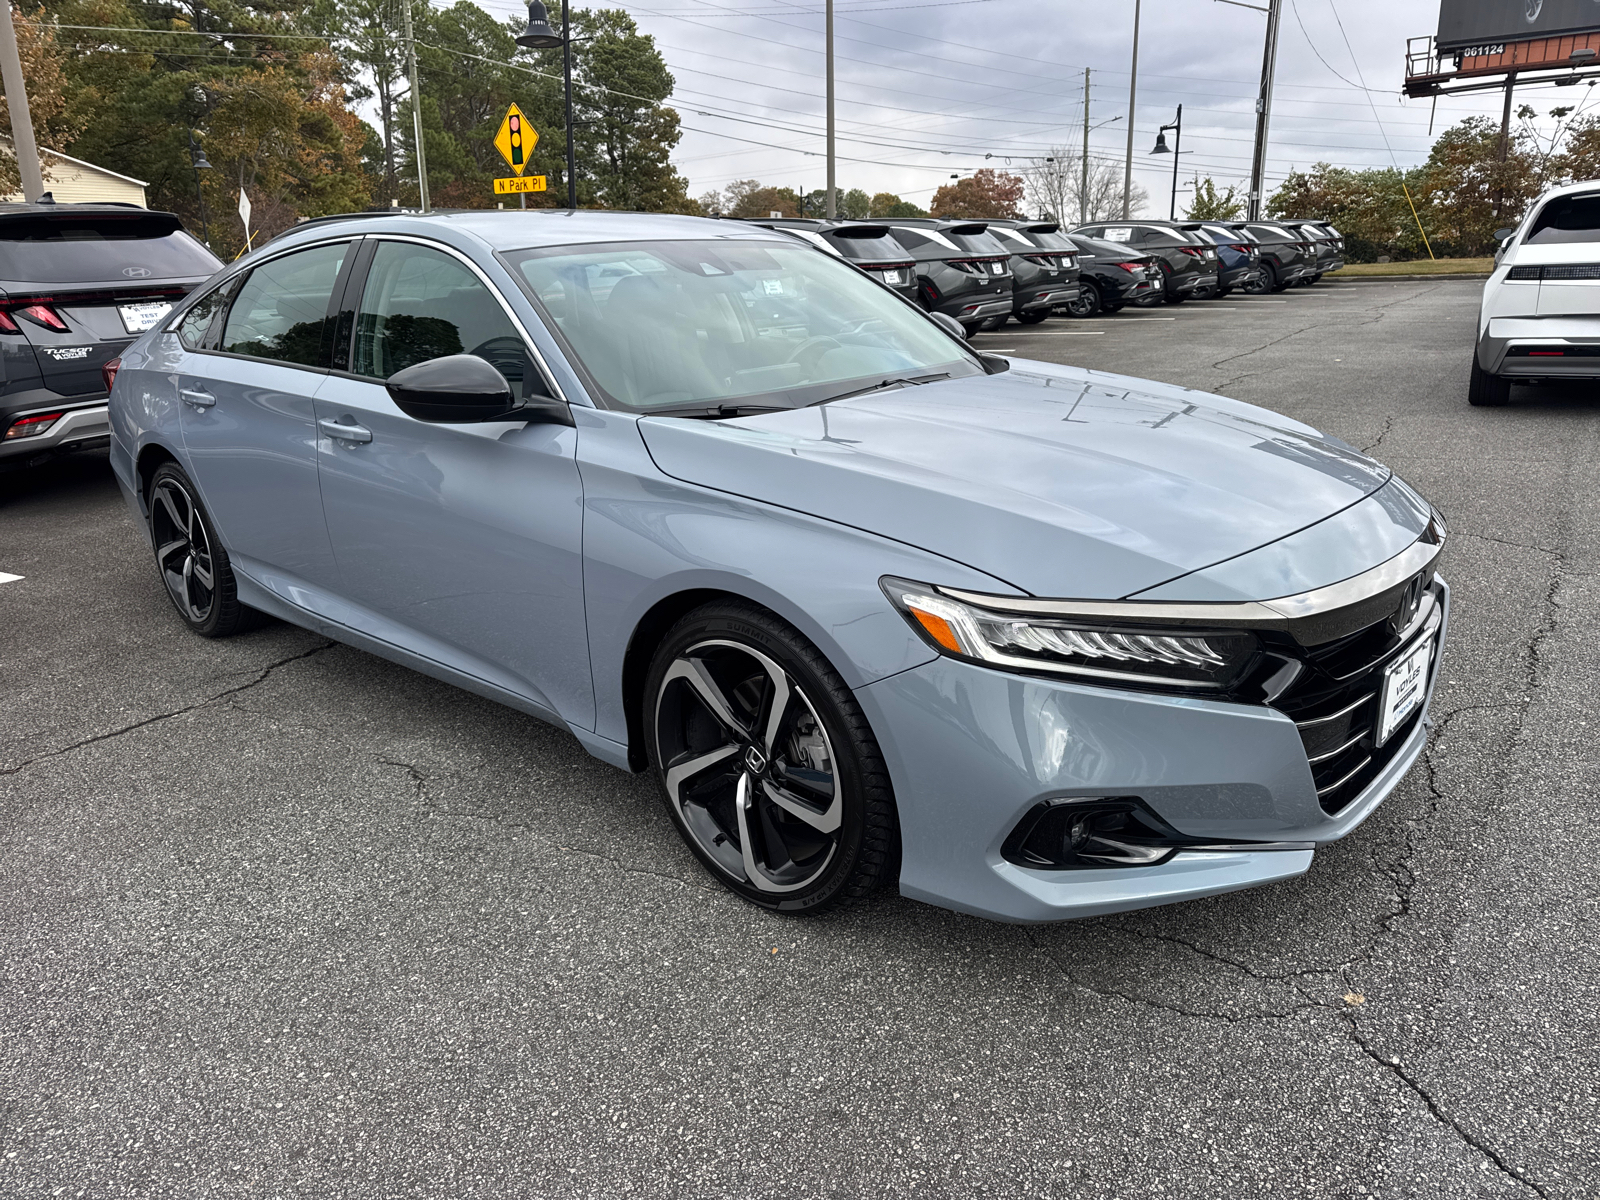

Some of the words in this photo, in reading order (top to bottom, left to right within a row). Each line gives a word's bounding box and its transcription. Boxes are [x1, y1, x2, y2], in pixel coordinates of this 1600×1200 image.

[1464, 44, 1504, 57] 061124
[499, 181, 505, 192] N
[510, 180, 528, 191] Park
[532, 178, 541, 189] Pl
[726, 621, 772, 644] SUMMIT
